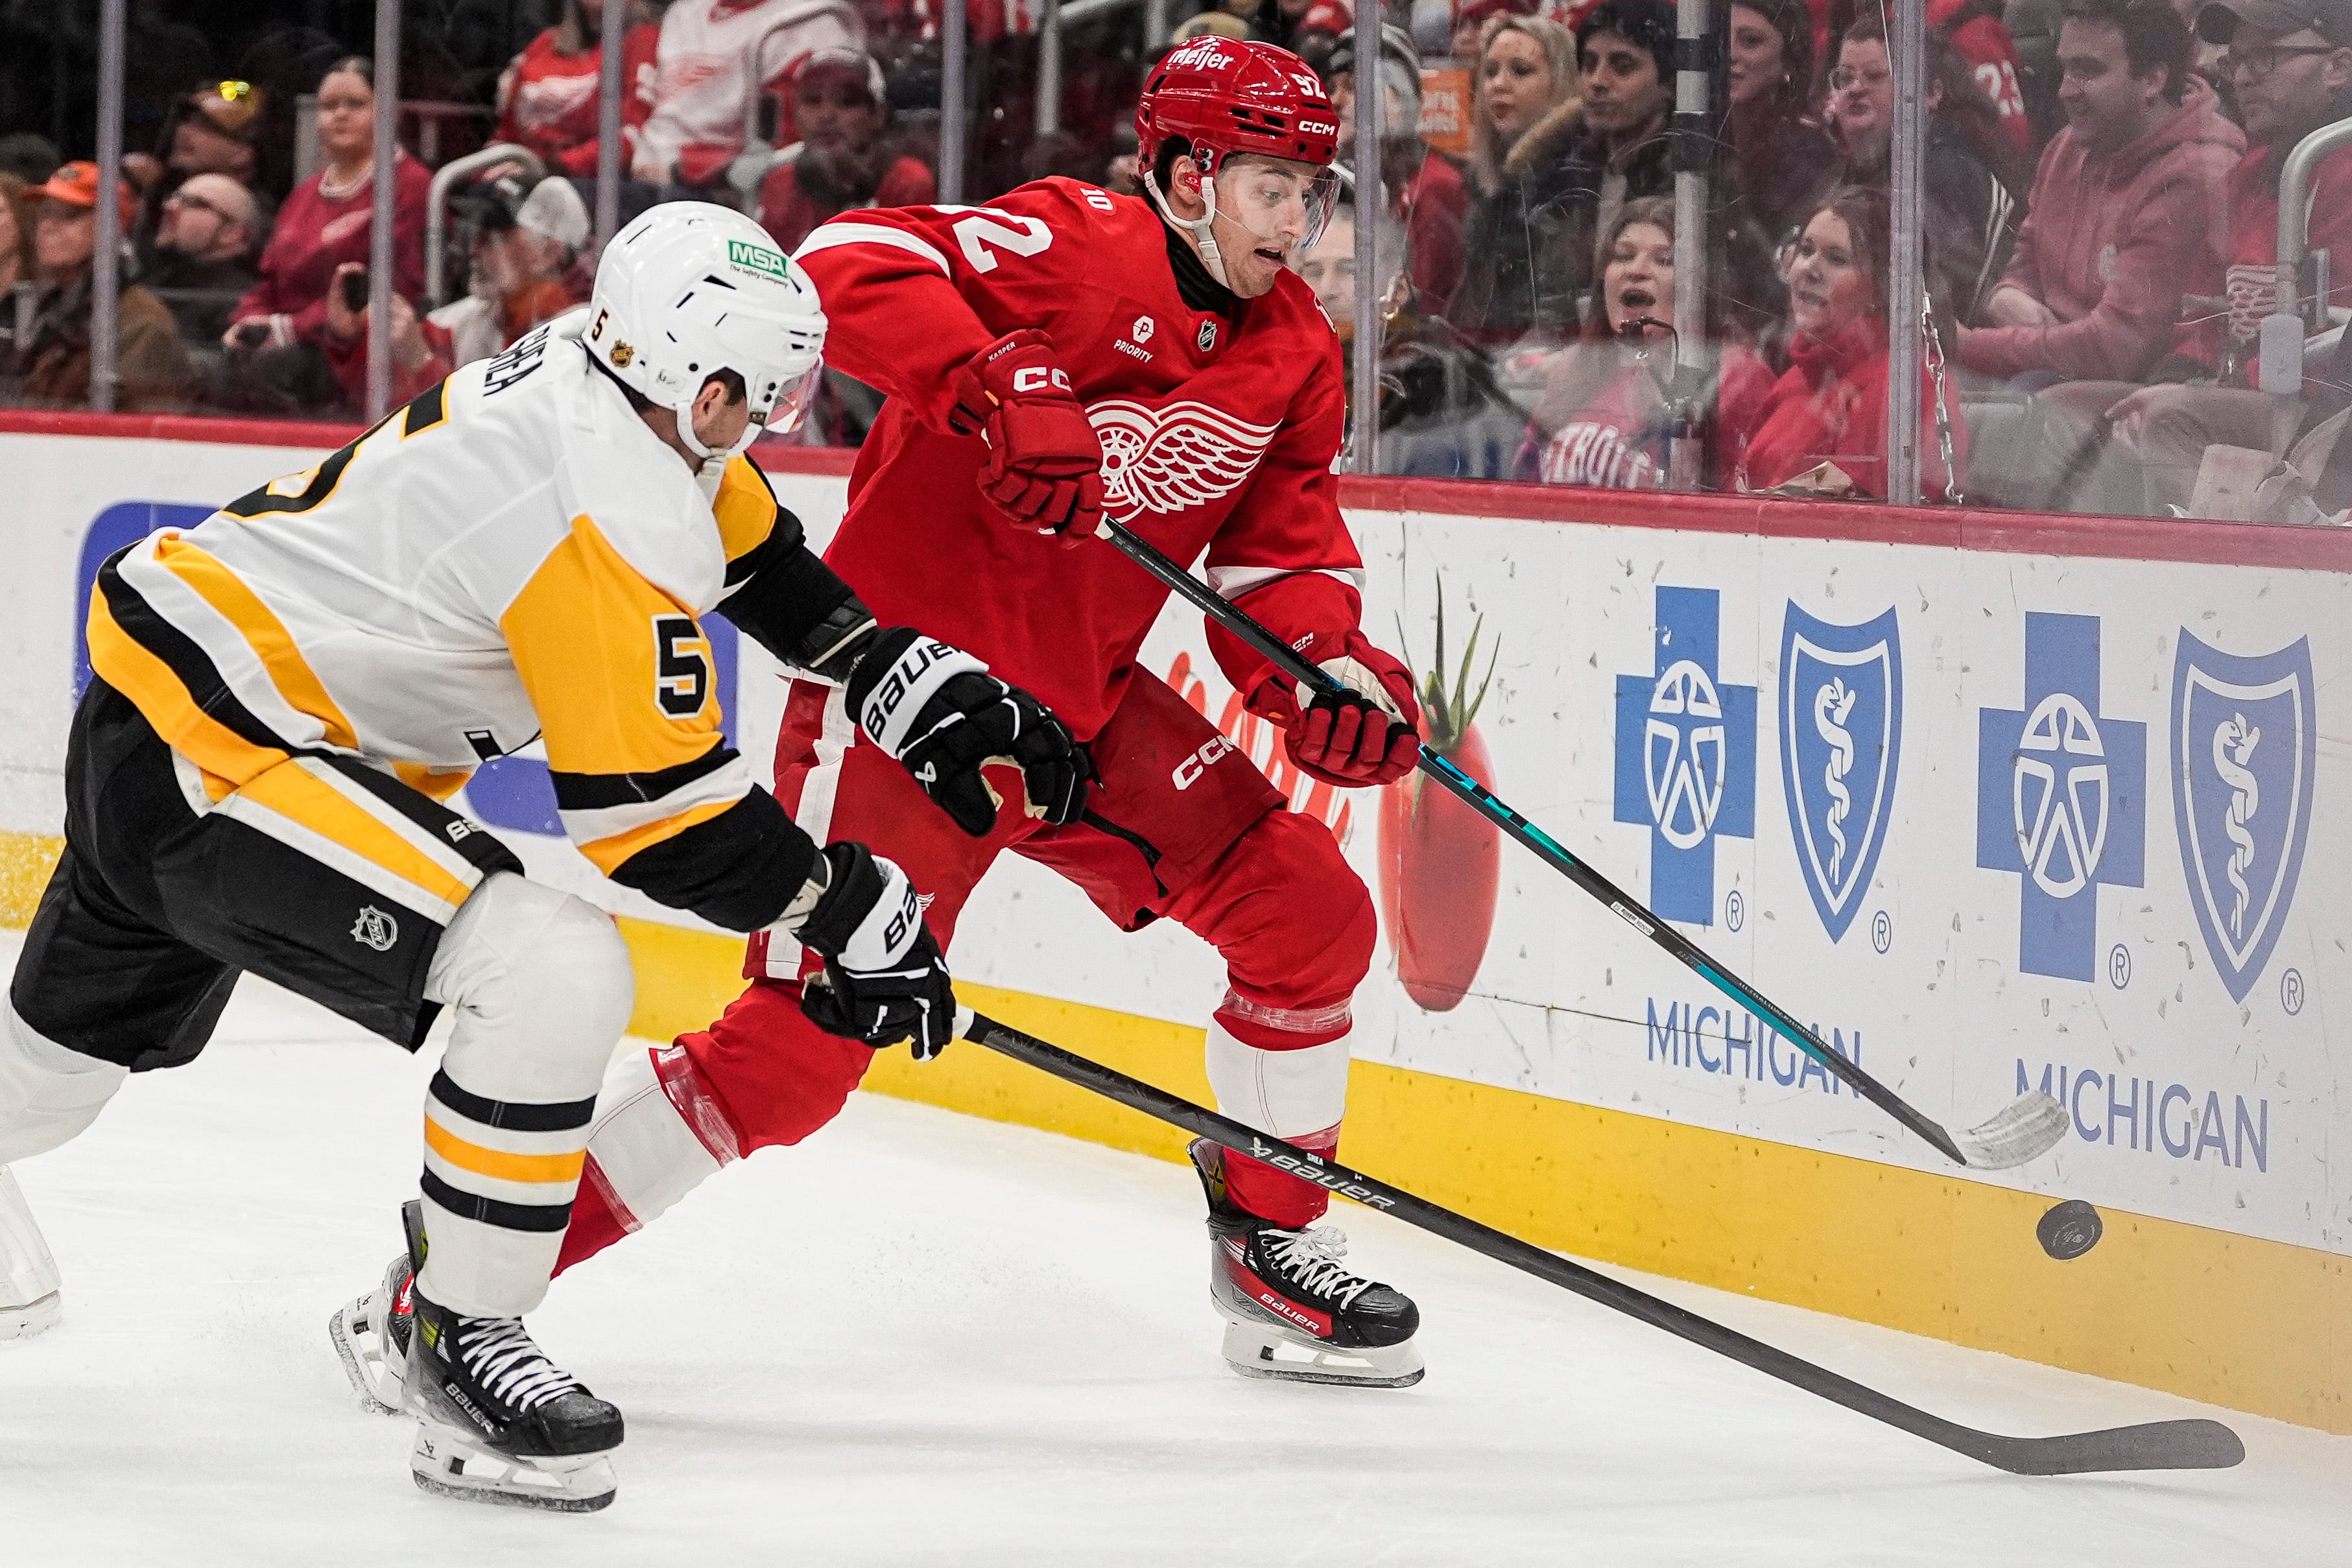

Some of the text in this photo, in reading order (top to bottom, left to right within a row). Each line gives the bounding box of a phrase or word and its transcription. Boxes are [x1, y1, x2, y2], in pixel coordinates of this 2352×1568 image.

[1167, 45, 1235, 71] meijer
[1298, 120, 1336, 136] CCM
[731, 242, 787, 276] MSA
[591, 308, 609, 342] 5
[988, 341, 1016, 362] KASPER
[1113, 339, 1154, 363] PRIORITY
[1013, 366, 1073, 393] CC
[1292, 632, 1314, 650] CM
[651, 612, 709, 720] 5
[866, 643, 962, 744] BAUE
[1307, 1152, 1324, 1167] SHEA
[1269, 1154, 1396, 1211] BAUER
[1259, 1292, 1320, 1332] BAUER
[445, 1382, 495, 1436] BAUER
